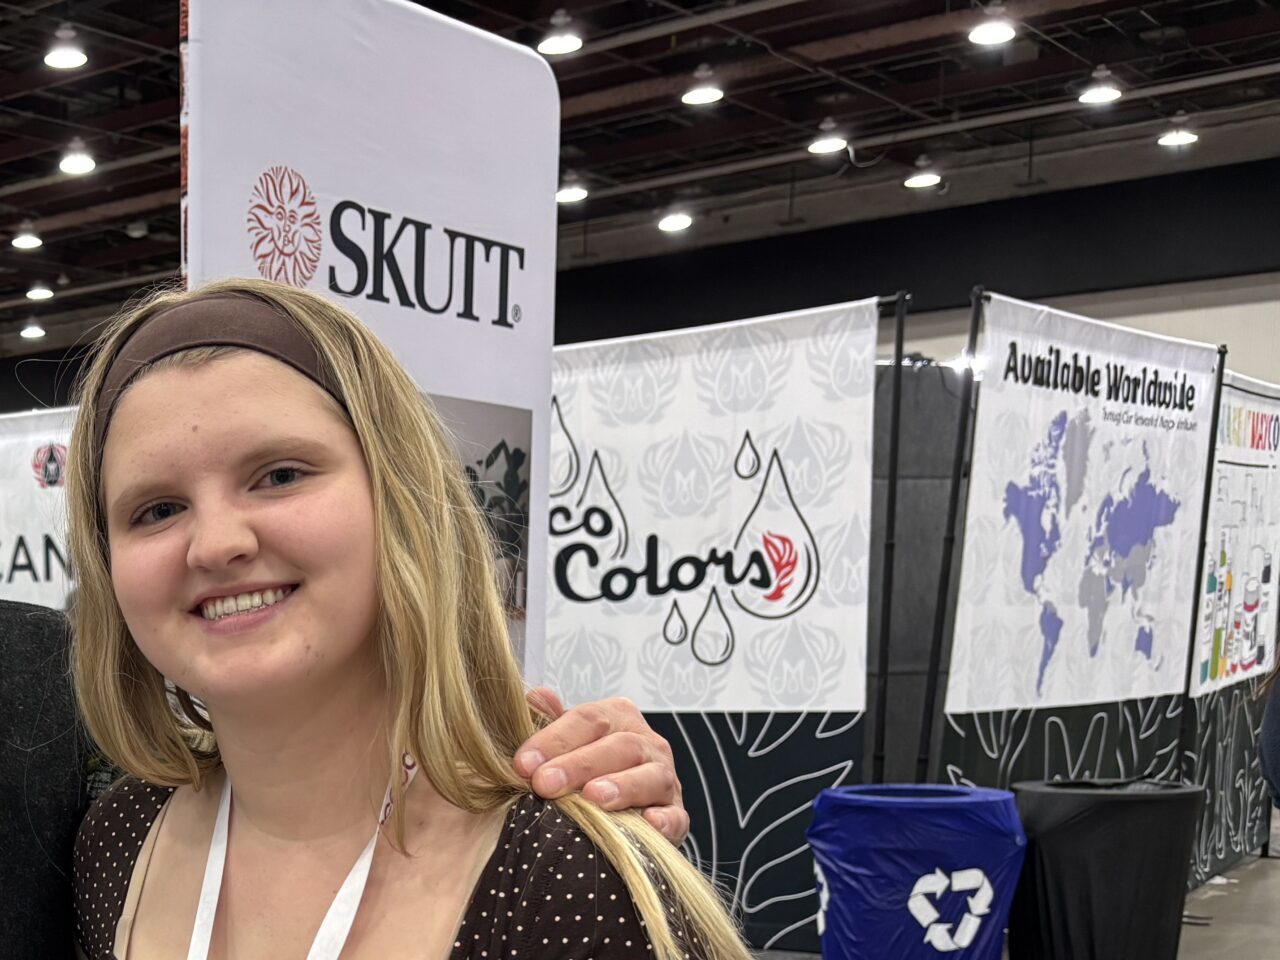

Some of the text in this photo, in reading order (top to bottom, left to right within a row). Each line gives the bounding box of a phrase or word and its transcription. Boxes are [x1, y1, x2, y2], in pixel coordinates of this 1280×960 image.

[1004, 341, 1196, 412] Available Worldwide
[554, 534, 772, 603] Colors
